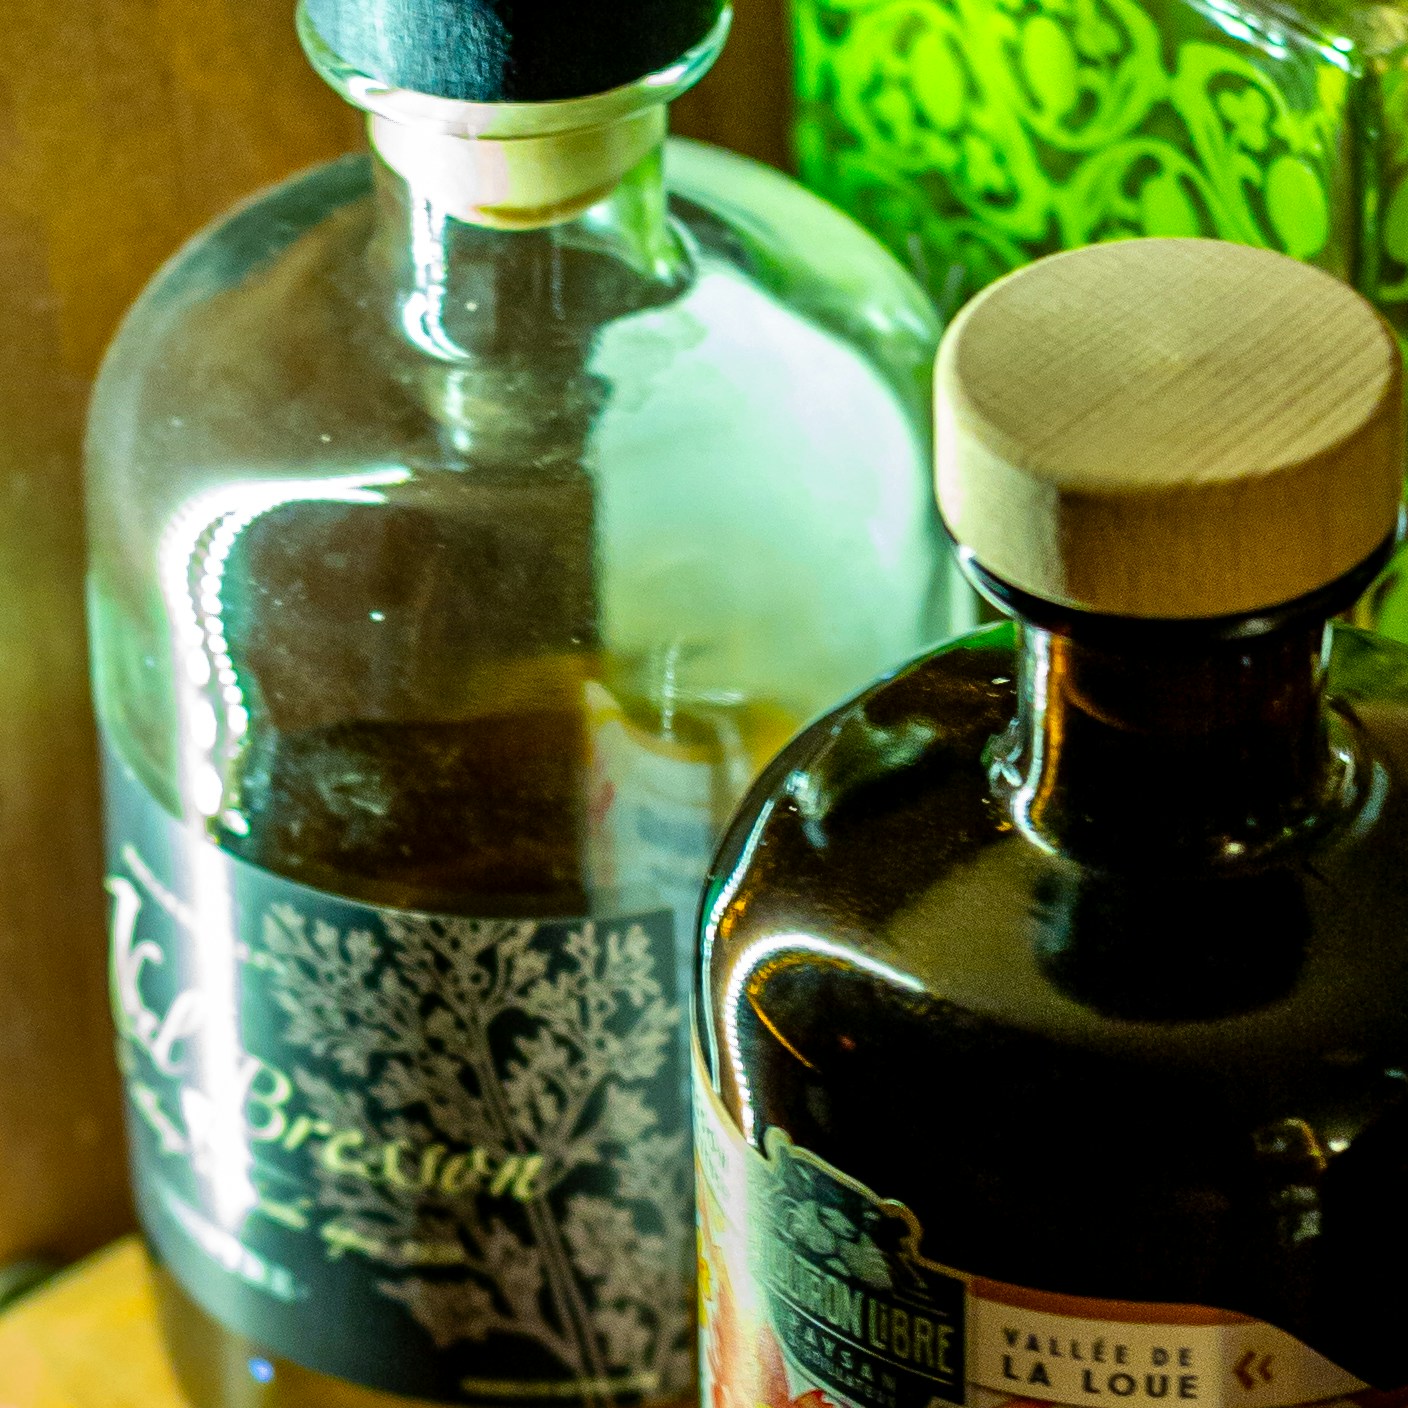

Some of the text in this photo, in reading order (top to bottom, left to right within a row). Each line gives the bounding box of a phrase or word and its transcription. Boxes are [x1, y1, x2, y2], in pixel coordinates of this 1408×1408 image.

[1003, 1326, 1193, 1368] VALLÉE DE
[1002, 1353, 1199, 1400] LA LOUE
